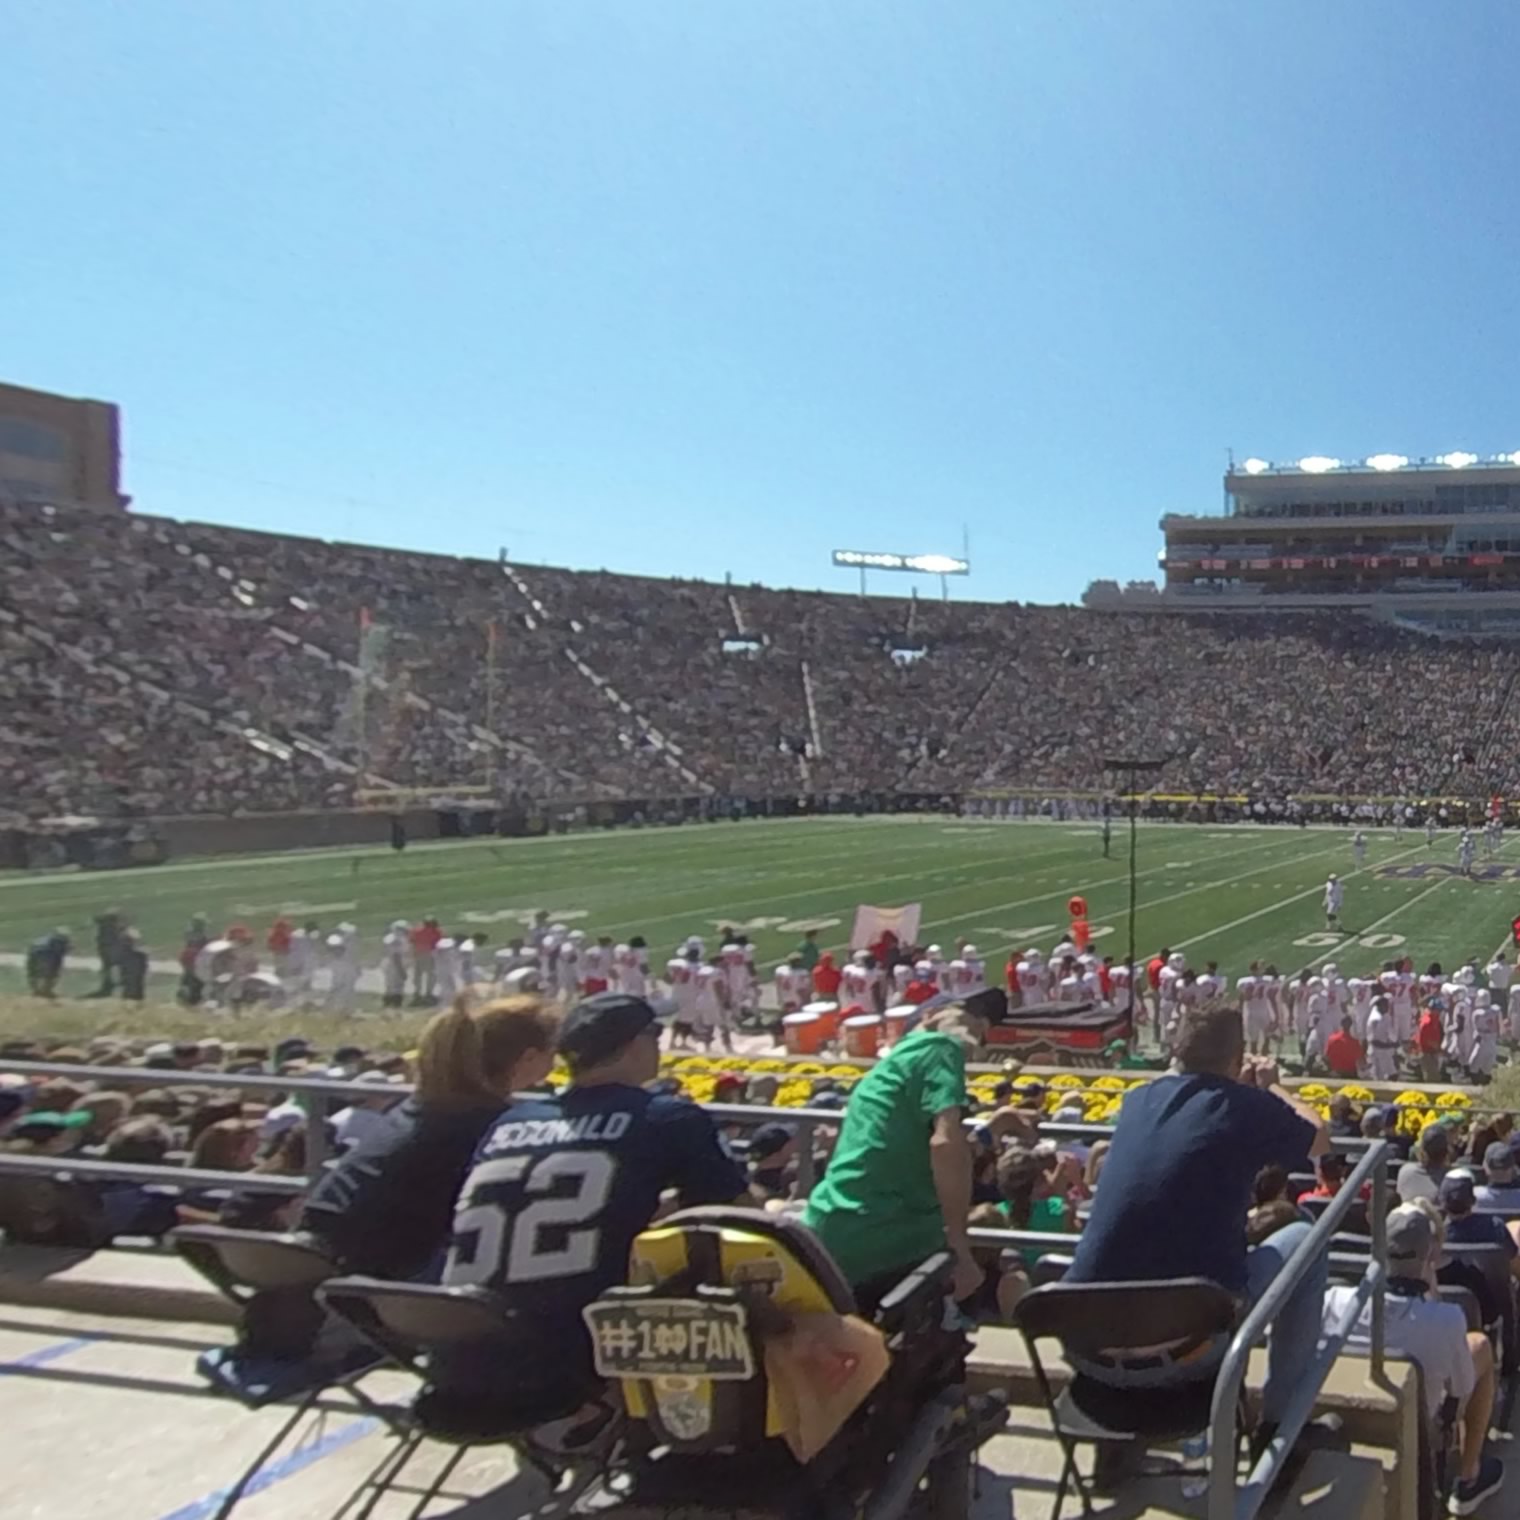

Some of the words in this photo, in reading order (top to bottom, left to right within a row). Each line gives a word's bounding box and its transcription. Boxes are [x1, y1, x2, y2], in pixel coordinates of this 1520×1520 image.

[1291, 932, 1406, 948] 50
[441, 1151, 614, 1286] 52
[689, 1320, 748, 1360] FAN
